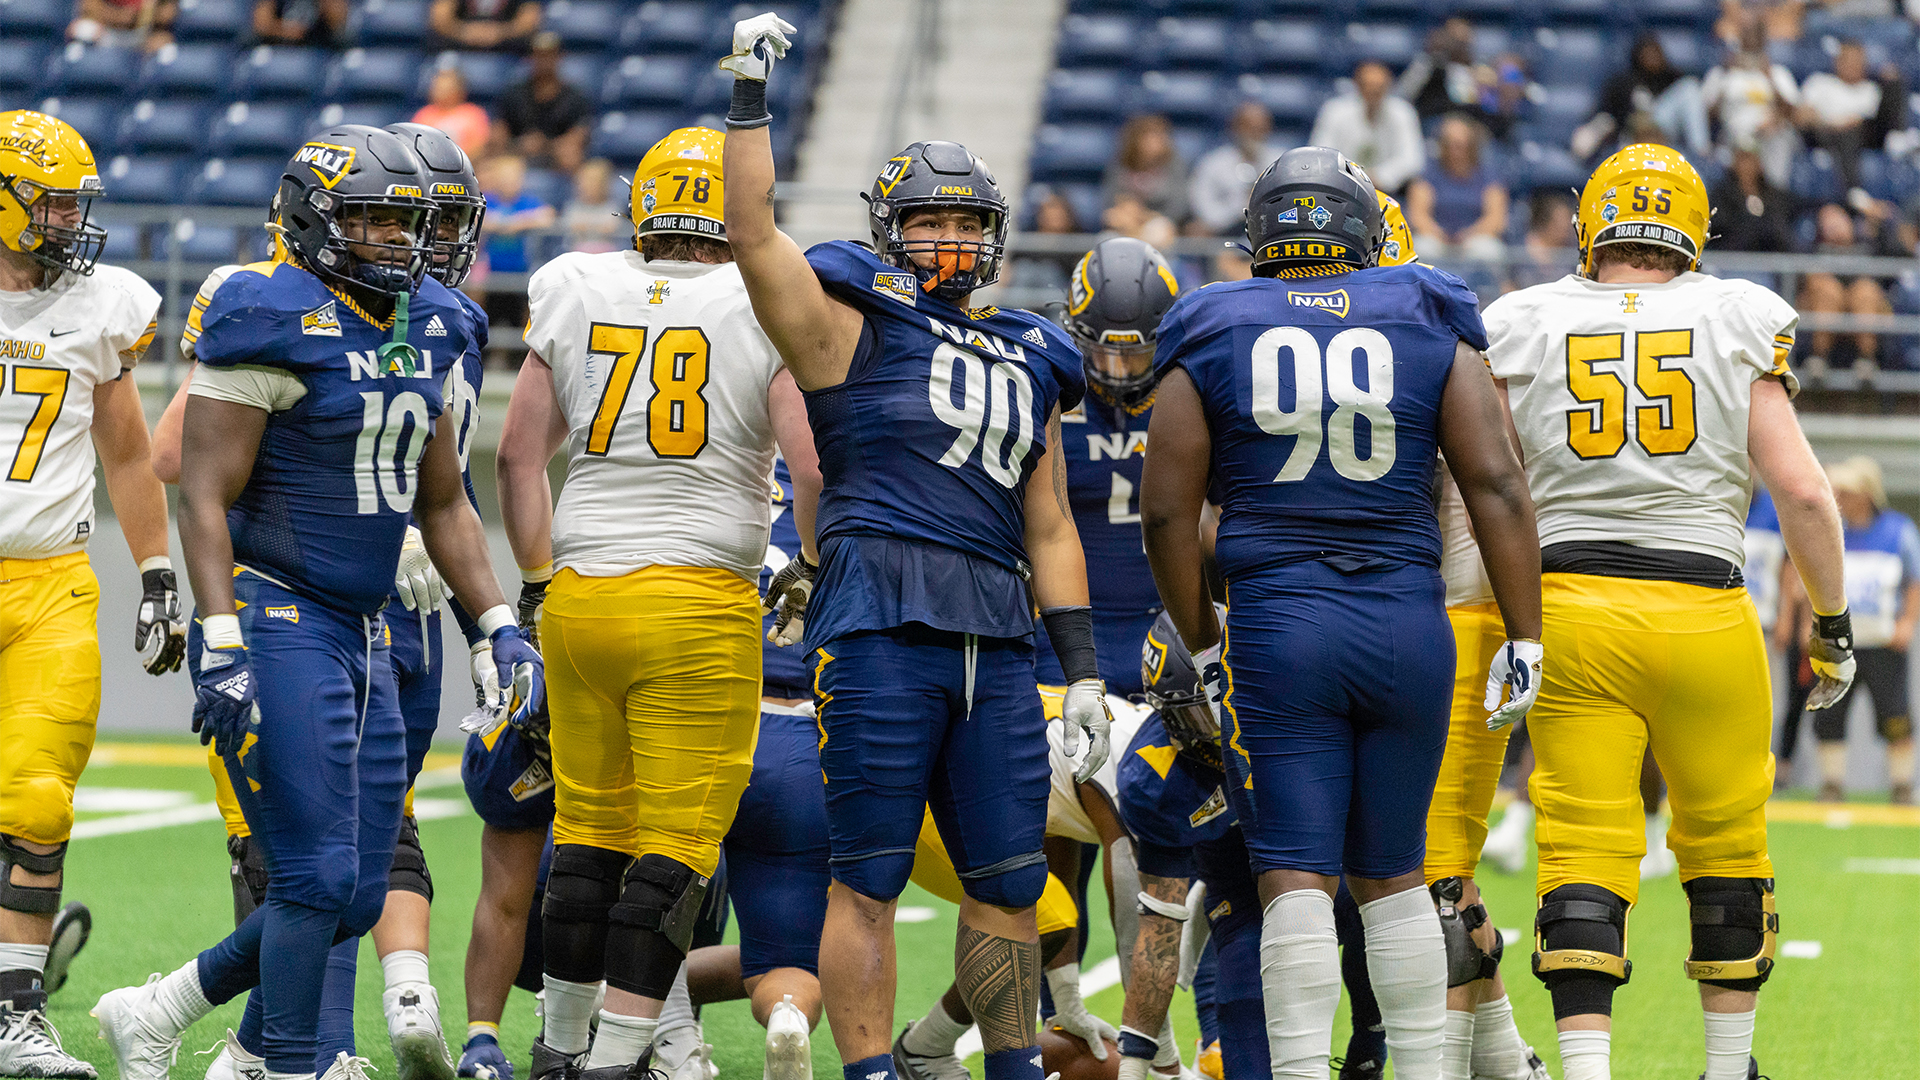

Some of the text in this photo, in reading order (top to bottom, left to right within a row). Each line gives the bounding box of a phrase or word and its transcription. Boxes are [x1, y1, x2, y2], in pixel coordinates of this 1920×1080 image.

[295, 147, 347, 173] NAU
[394, 186, 423, 198] NAU
[436, 184, 465, 195] NAU
[672, 175, 711, 204] 78
[941, 185, 973, 196] NAU
[1631, 185, 1672, 215] 55
[652, 217, 720, 235] BRAVE AND BOLD
[1615, 224, 1683, 246] BRAVE AND BOLD
[1266, 243, 1347, 259] C.H.O.P.
[1294, 294, 1344, 309] NAU
[424, 328, 448, 337] adidas
[926, 316, 1027, 364] NAU
[1021, 333, 1048, 350] adidas
[0, 339, 46, 361] AHO
[584, 321, 712, 460] 78
[1565, 327, 1699, 461] 55
[929, 341, 1034, 489] 90
[1251, 326, 1397, 482] 98
[0, 363, 71, 483] 7
[353, 391, 429, 515] 10
[268, 610, 296, 618] NAU
[214, 671, 249, 692] adidas
[1562, 955, 1607, 966] DONJOY
